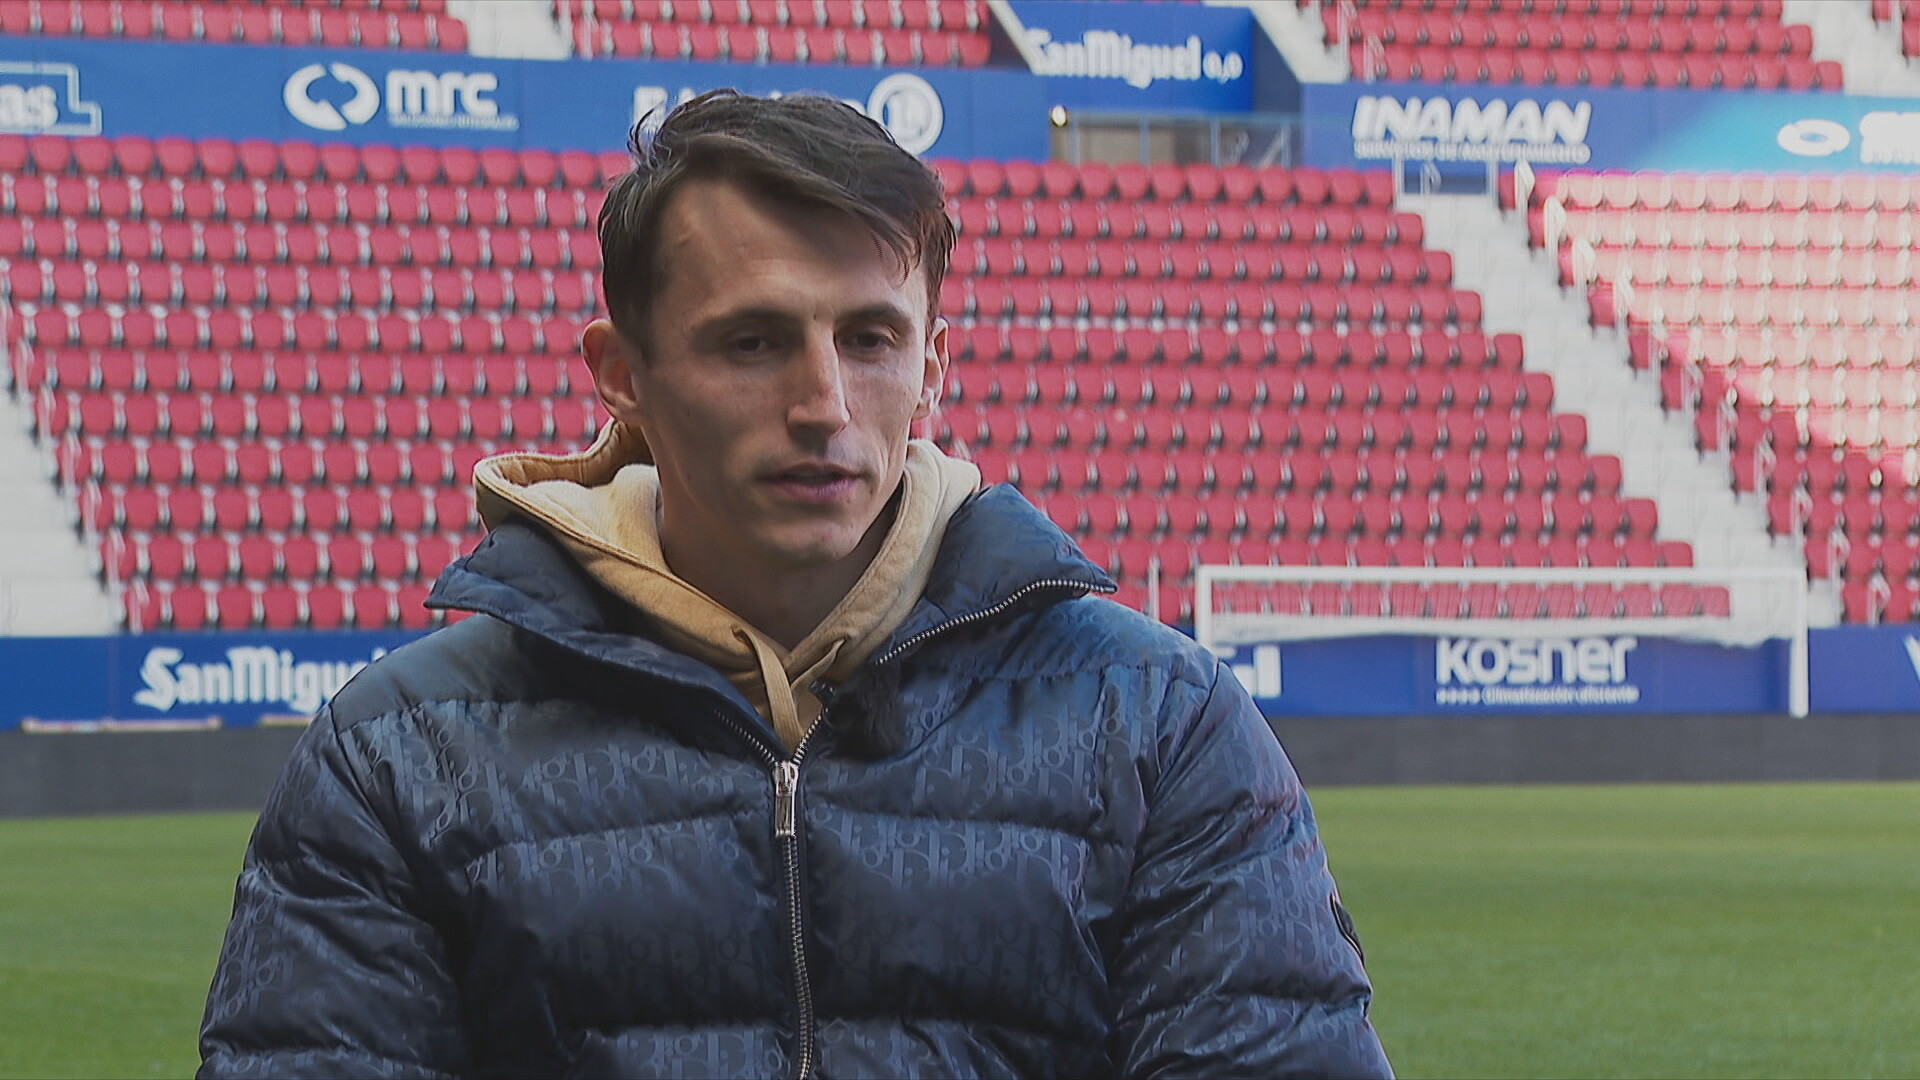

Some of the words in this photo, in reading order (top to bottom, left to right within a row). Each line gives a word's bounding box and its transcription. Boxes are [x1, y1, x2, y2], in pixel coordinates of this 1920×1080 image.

[386, 69, 498, 116] mrc
[1352, 96, 1592, 145] INAMAN
[134, 646, 387, 712] SanMigu
